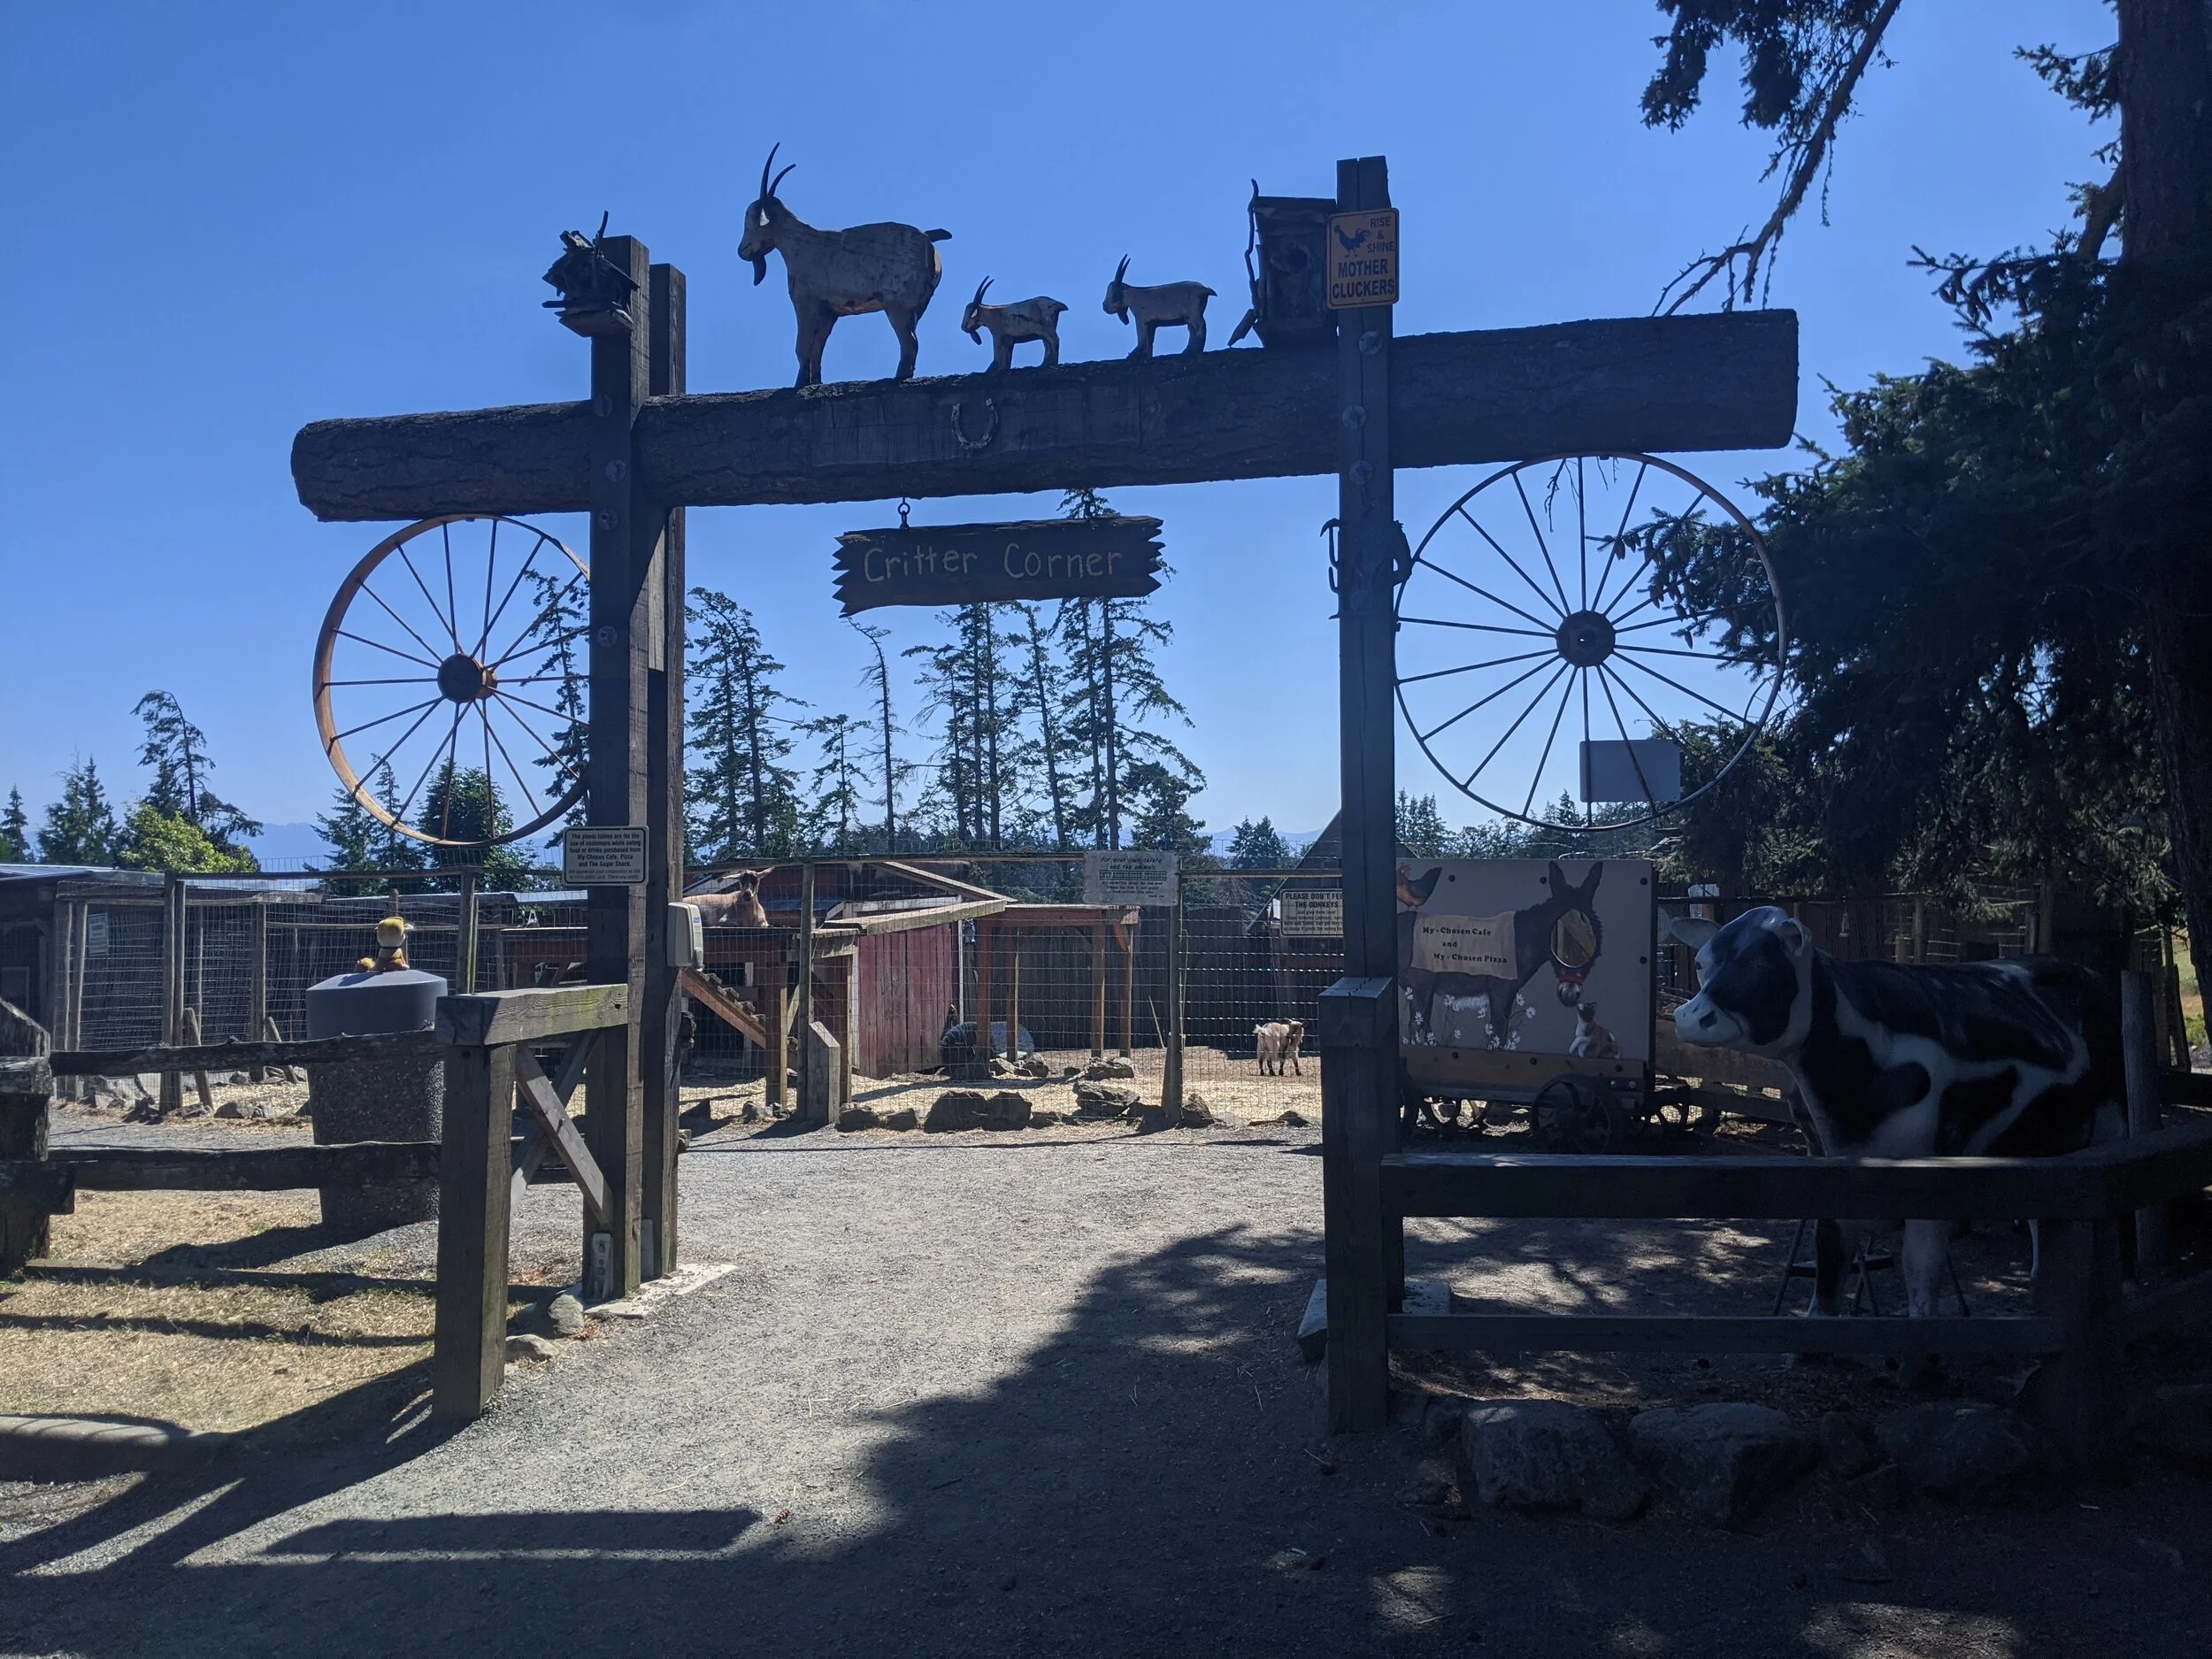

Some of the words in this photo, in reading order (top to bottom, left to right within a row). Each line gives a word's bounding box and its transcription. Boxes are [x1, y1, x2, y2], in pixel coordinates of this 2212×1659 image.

[1371, 217, 1391, 228] RISE
[1377, 230, 1384, 240] &
[1367, 241, 1395, 253] SHINE
[1338, 258, 1388, 278] MOTHER
[1333, 279, 1395, 299] CLUCKERS
[864, 544, 978, 582] Critter
[1004, 542, 1123, 579] Corner
[1484, 955, 1508, 964] Pizza
